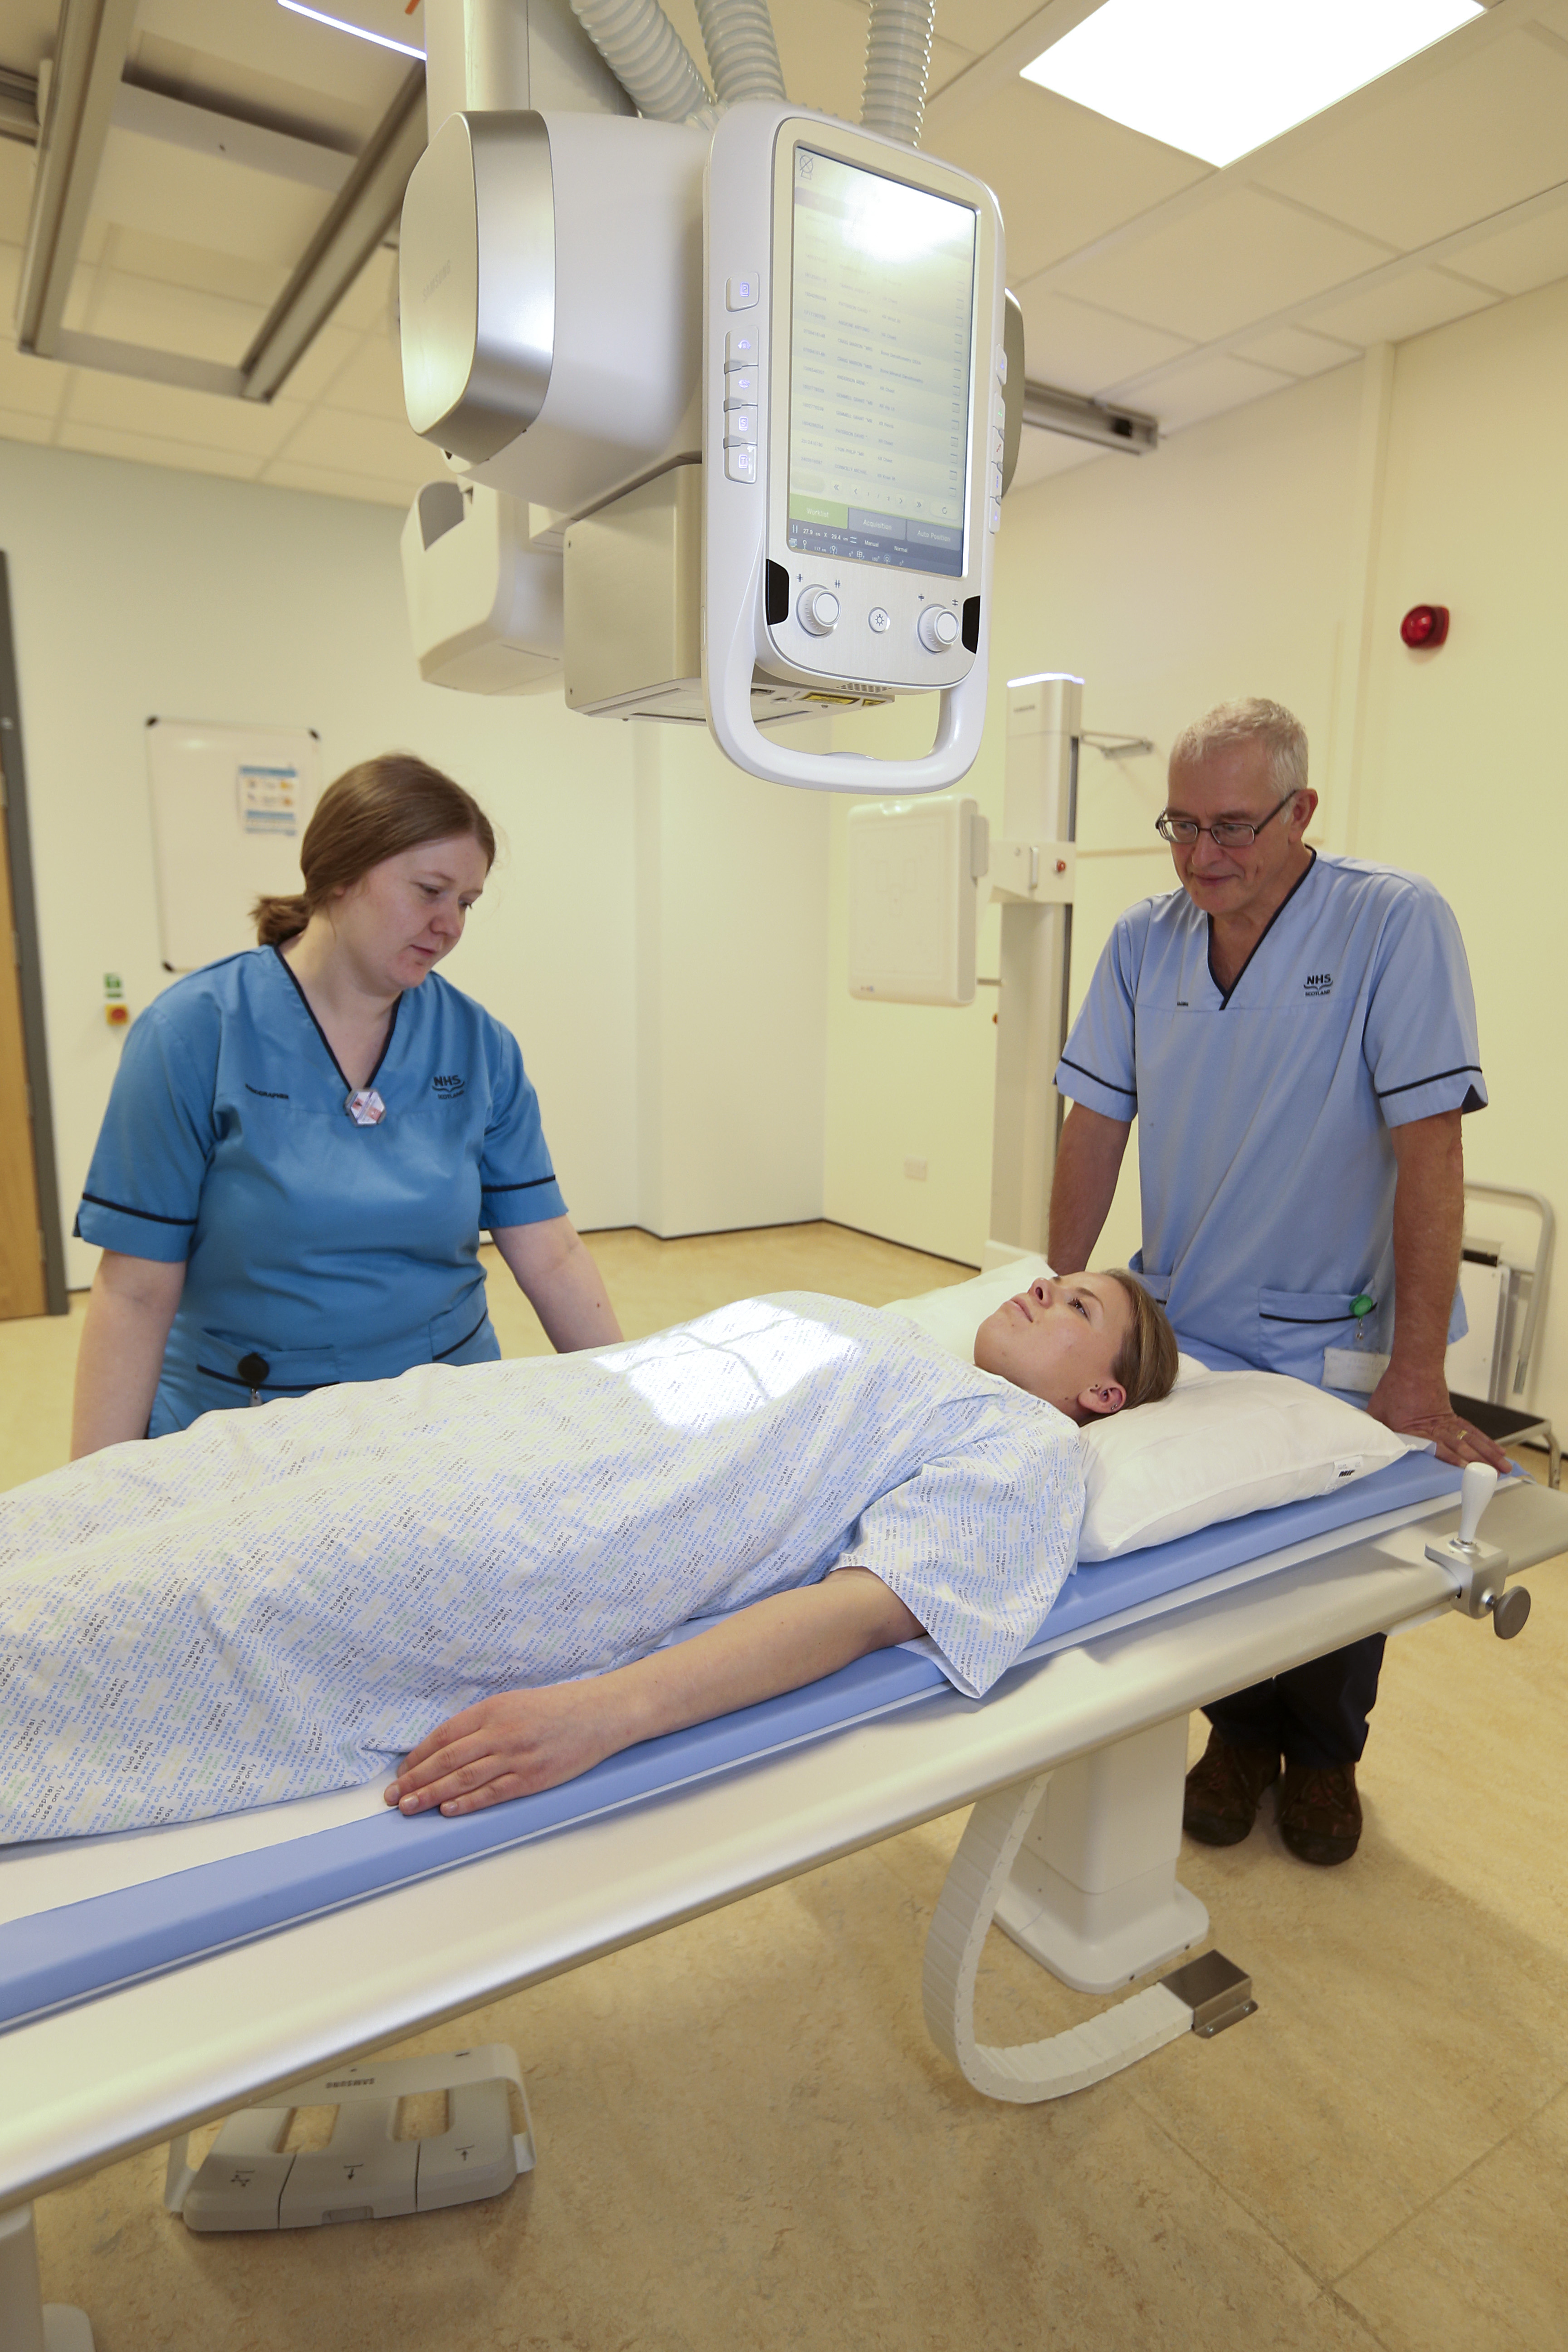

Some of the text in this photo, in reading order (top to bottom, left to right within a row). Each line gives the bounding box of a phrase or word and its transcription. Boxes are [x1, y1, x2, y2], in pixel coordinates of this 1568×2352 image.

[806, 508, 829, 518] Worklist
[863, 519, 892, 530] Acquisition
[917, 530, 951, 542] Auto Position
[1307, 974, 1331, 984] NHS
[434, 1075, 461, 1086] NHS
[532, 1477, 549, 1498] use only
[594, 1468, 610, 1487] hospital
[608, 1471, 617, 1481] only
[540, 1480, 556, 1500] hospital
[464, 1494, 481, 1513] hospital
[471, 1497, 489, 1516] use only
[672, 1496, 690, 1519] use only
[677, 1499, 695, 1520] hospital
[614, 1514, 630, 1535] hospital
[621, 1515, 638, 1538] use only
[548, 1532, 565, 1554] use only
[555, 1534, 573, 1556] hospital
[738, 1534, 752, 1555] hospital
[750, 1536, 759, 1547] only
[239, 1548, 261, 1571] use only
[248, 1551, 270, 1573] hospital
[478, 1547, 497, 1570] hospital
[486, 1549, 506, 1573] use only
[404, 1564, 426, 1589] use only
[413, 1568, 434, 1592] hospital
[622, 1570, 638, 1593] hospital
[627, 1572, 646, 1595] use only
[158, 1578, 180, 1605] hospital
[167, 1578, 188, 1607] use only
[329, 1585, 351, 1610] hospital
[337, 1586, 359, 1613] use only
[250, 1606, 272, 1634] use only
[257, 1609, 279, 1635] hospital
[485, 1606, 505, 1630] hospital
[501, 1608, 513, 1621] only
[77, 1613, 99, 1645] use only
[87, 1615, 109, 1644] hospital
[412, 1625, 435, 1649] use only
[421, 1628, 442, 1651] hospital
[181, 1638, 201, 1667] hospital
[190, 1638, 210, 1669] use only
[334, 1646, 356, 1668] hospital
[341, 1647, 364, 1669] use only
[561, 1646, 582, 1668] use only
[568, 1648, 588, 1670] hospital
[99, 1678, 120, 1709] use only
[109, 1680, 129, 1709] hospital
[204, 1701, 222, 1730] hospital
[214, 1701, 232, 1731] use only
[342, 1698, 362, 1725] hospital
[349, 1700, 370, 1728] use only
[13, 1719, 36, 1749] hospital
[23, 1719, 46, 1752] use only
[122, 1740, 144, 1773] use only
[132, 1742, 154, 1772] hospital
[227, 1764, 247, 1793] hospital
[236, 1763, 257, 1795] use only
[30, 1785, 54, 1818] hospital
[41, 1785, 65, 1820] use only
